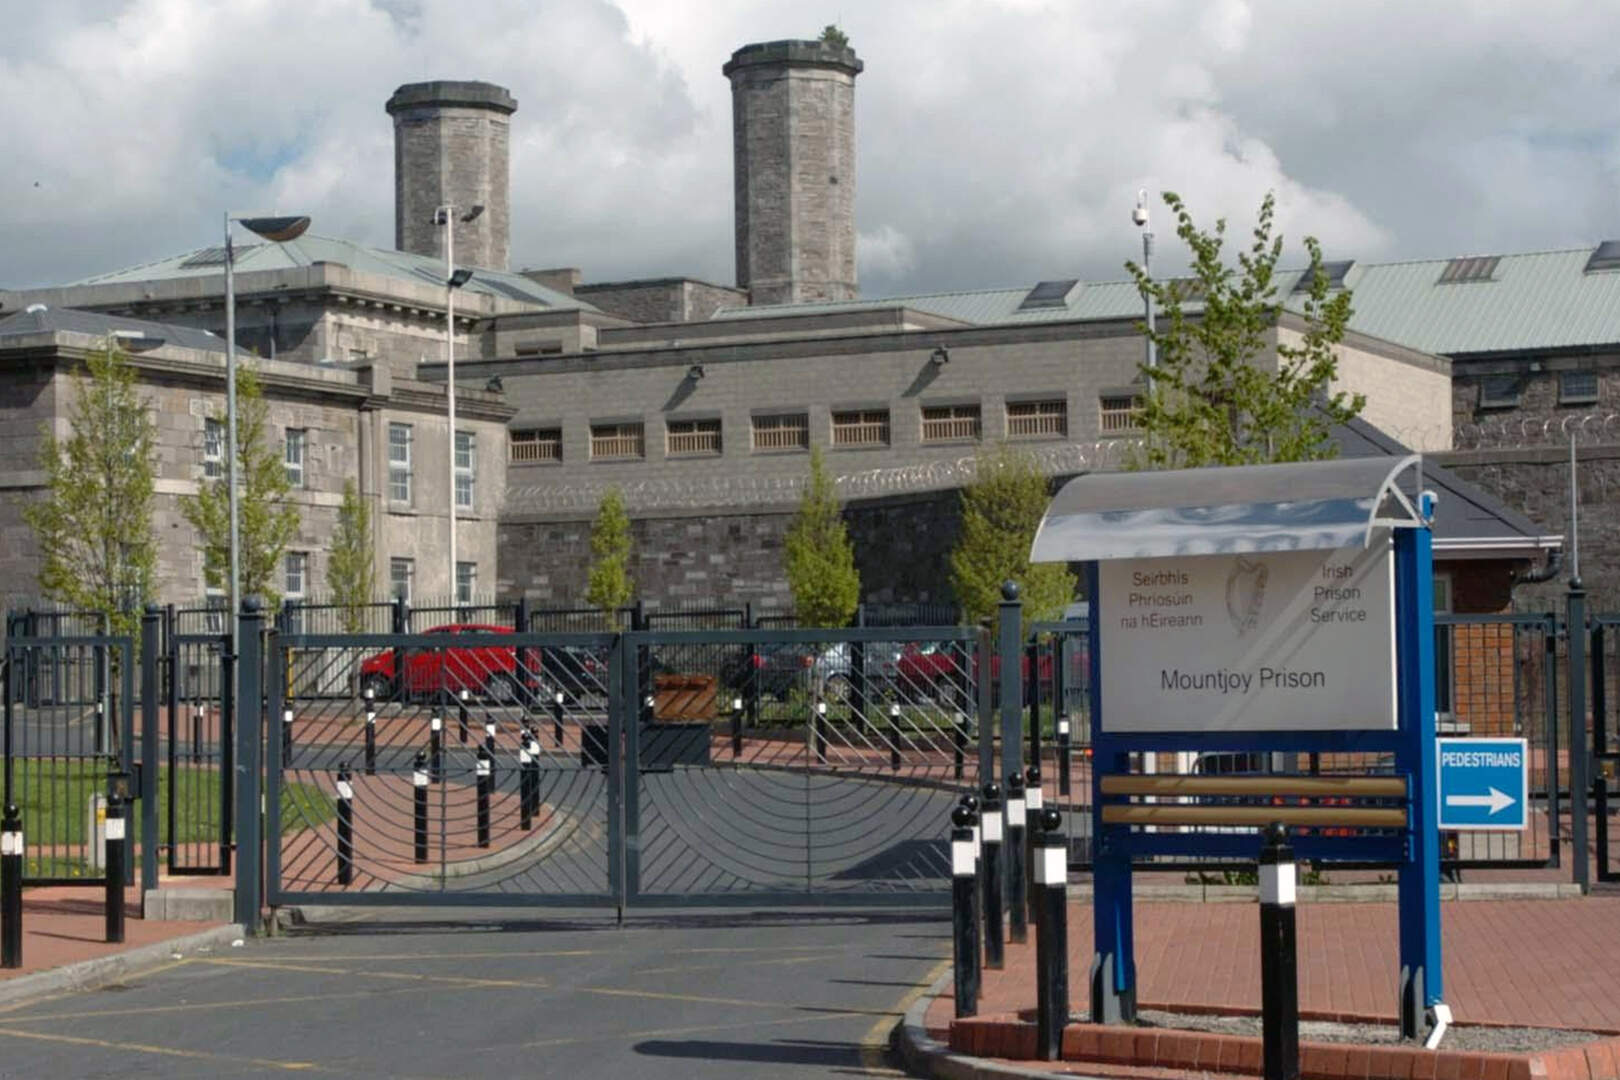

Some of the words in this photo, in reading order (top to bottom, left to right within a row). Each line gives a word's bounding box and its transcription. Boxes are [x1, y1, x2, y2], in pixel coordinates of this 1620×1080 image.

[1322, 564, 1353, 579] Irish
[1314, 585, 1361, 600] Prison
[1121, 615, 1137, 629] na
[1311, 607, 1366, 623] Service
[1161, 669, 1252, 694] Mountjoy
[1260, 667, 1326, 689] Prison
[1442, 752, 1520, 768] PEDESTRIANS
